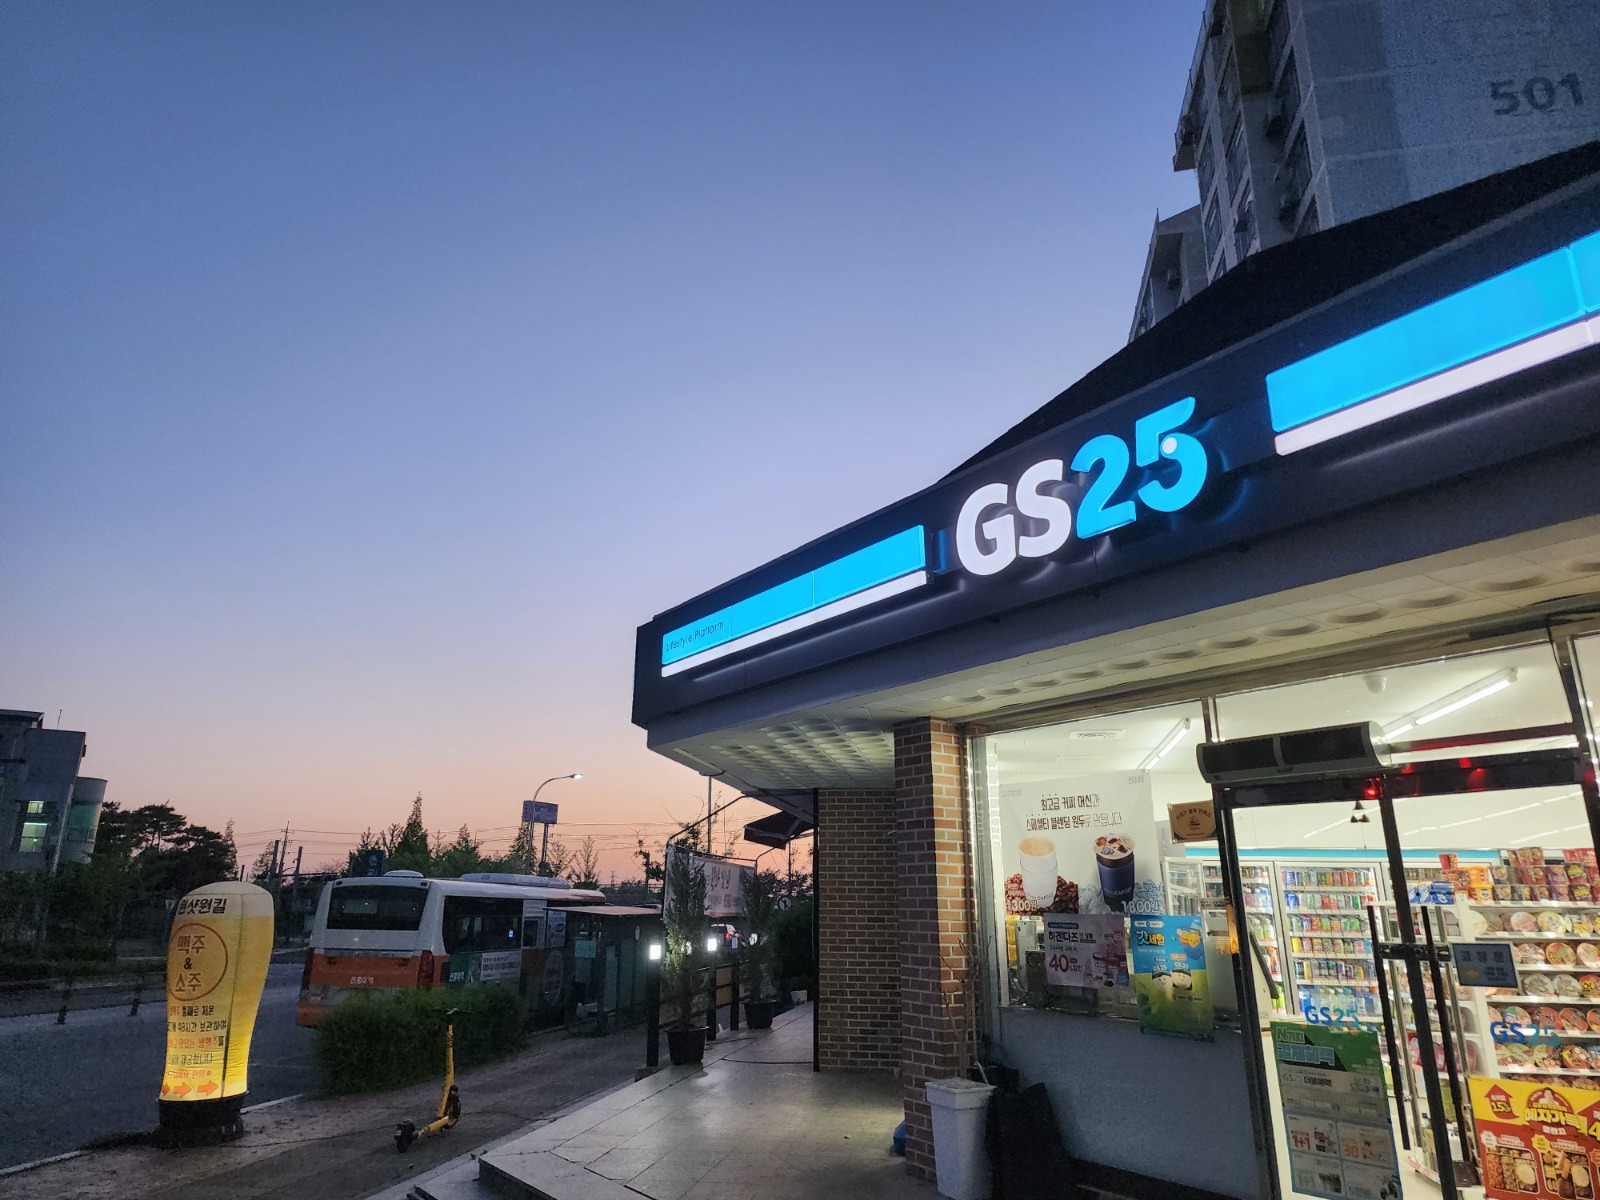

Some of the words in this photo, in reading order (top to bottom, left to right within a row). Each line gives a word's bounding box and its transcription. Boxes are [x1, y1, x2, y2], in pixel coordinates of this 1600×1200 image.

[1490, 72, 1584, 115] 501
[956, 397, 1207, 576] GS25
[666, 634, 692, 652] Lifestyle
[694, 621, 724, 640] Platform
[1041, 798, 1060, 811] 최고급
[1062, 796, 1076, 809] 커피
[1077, 794, 1100, 808] 머신과
[1026, 817, 1050, 831] 스페셜티
[1051, 816, 1071, 830] 블렌딩
[178, 898, 227, 915] 원샷원킬
[1006, 900, 1037, 912] 1300원
[1121, 900, 1160, 914] 1800원
[178, 935, 206, 955] 맥주
[1048, 931, 1079, 943] 하겐다즈
[183, 957, 192, 969] &
[175, 973, 202, 992] 소주
[1305, 1005, 1361, 1028] GS25
[200, 1020, 227, 1032] 보관하여
[1490, 1021, 1561, 1047] GS25
